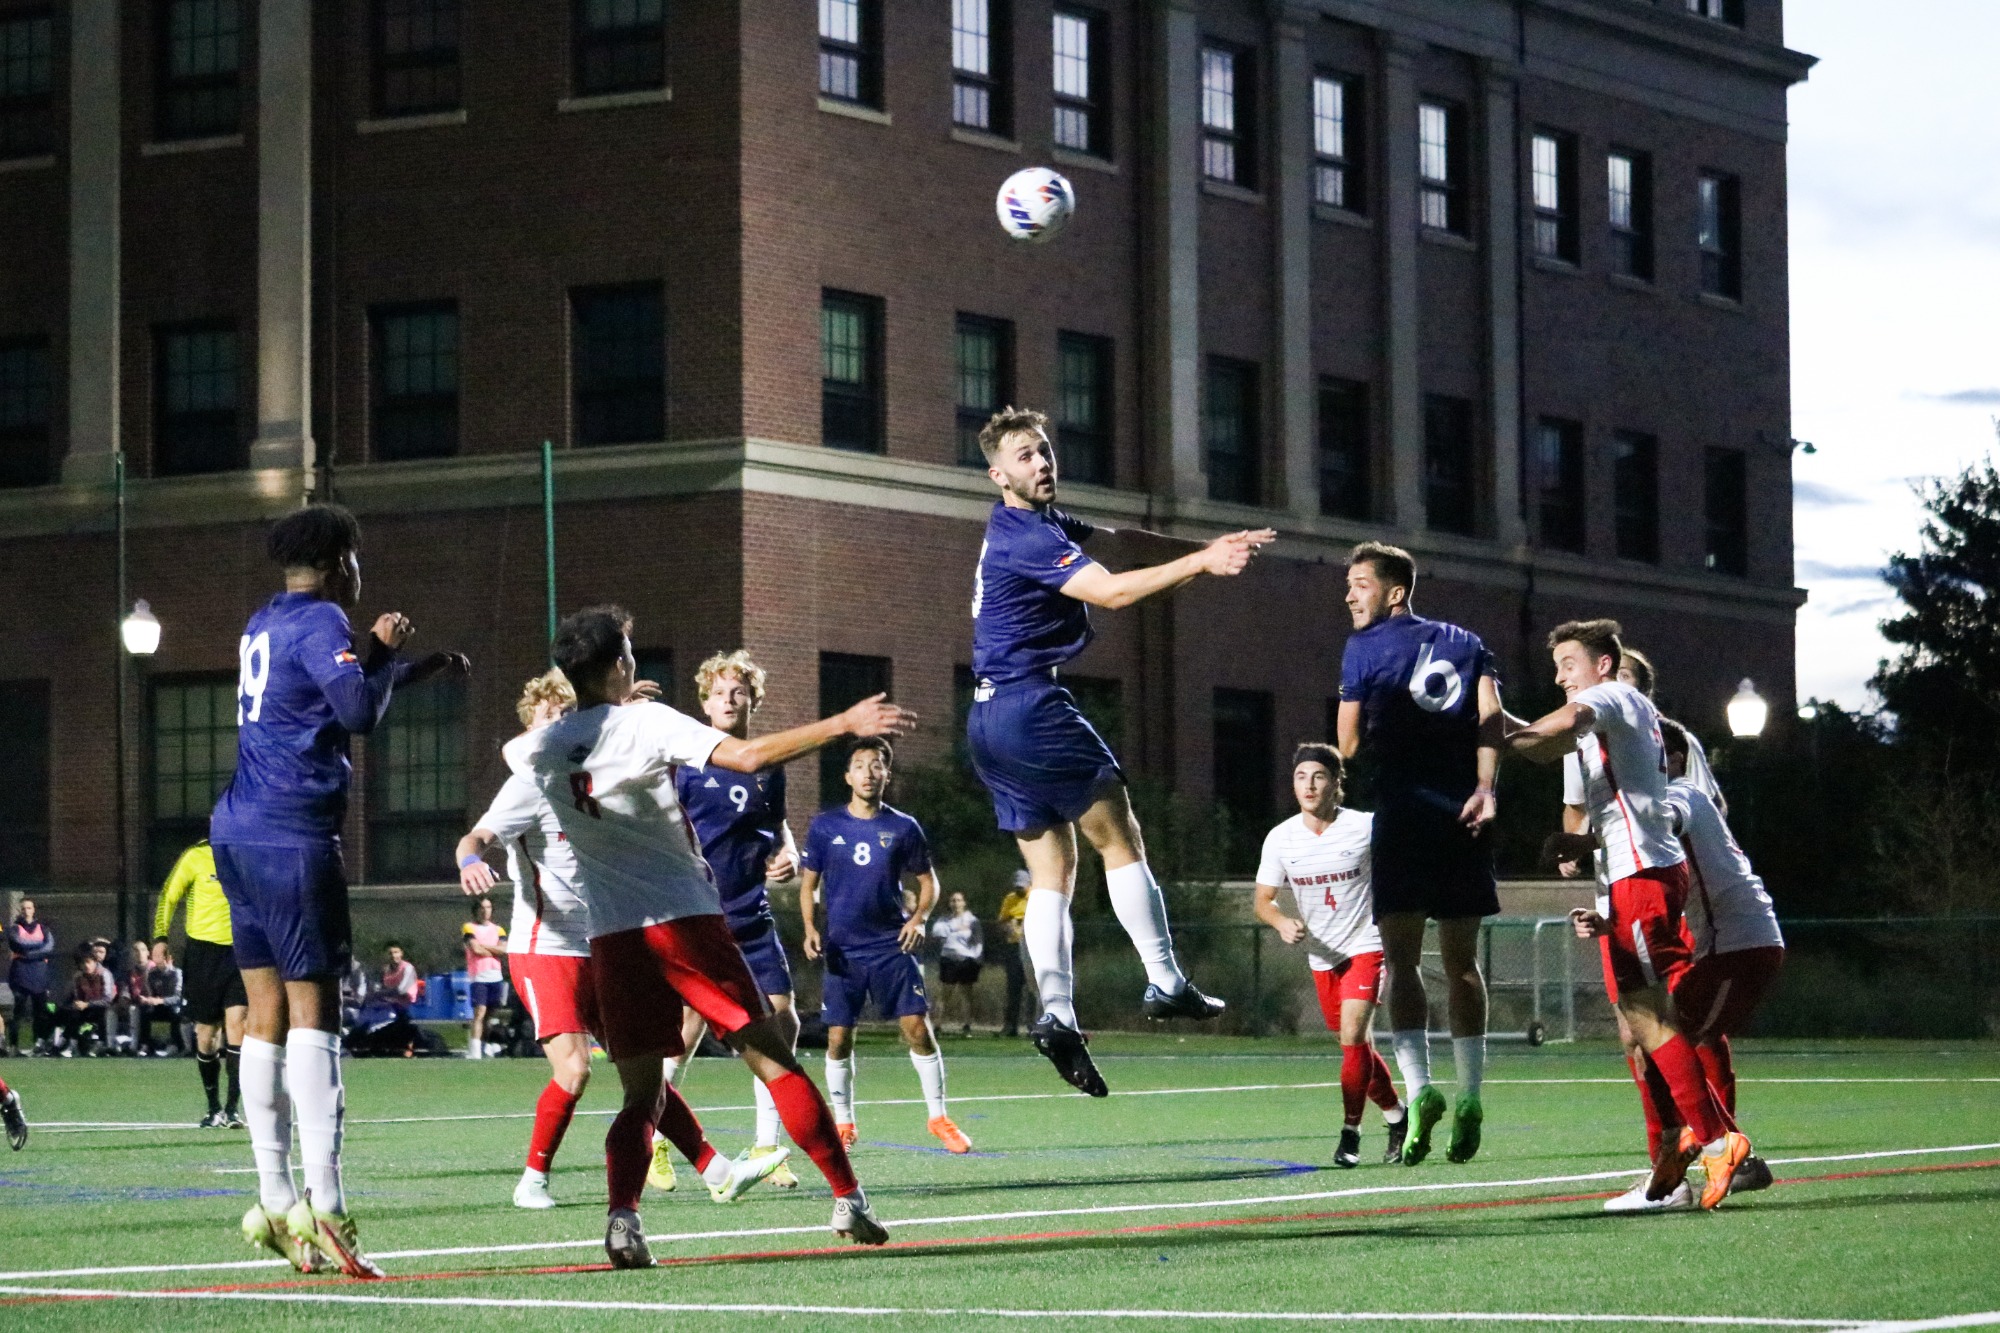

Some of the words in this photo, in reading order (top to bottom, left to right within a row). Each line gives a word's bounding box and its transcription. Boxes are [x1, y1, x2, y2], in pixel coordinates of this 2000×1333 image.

[1409, 643, 1461, 712] 6
[570, 771, 602, 820] 8
[729, 785, 748, 812] 9
[853, 842, 871, 866] 8
[1324, 887, 1336, 911] 4
